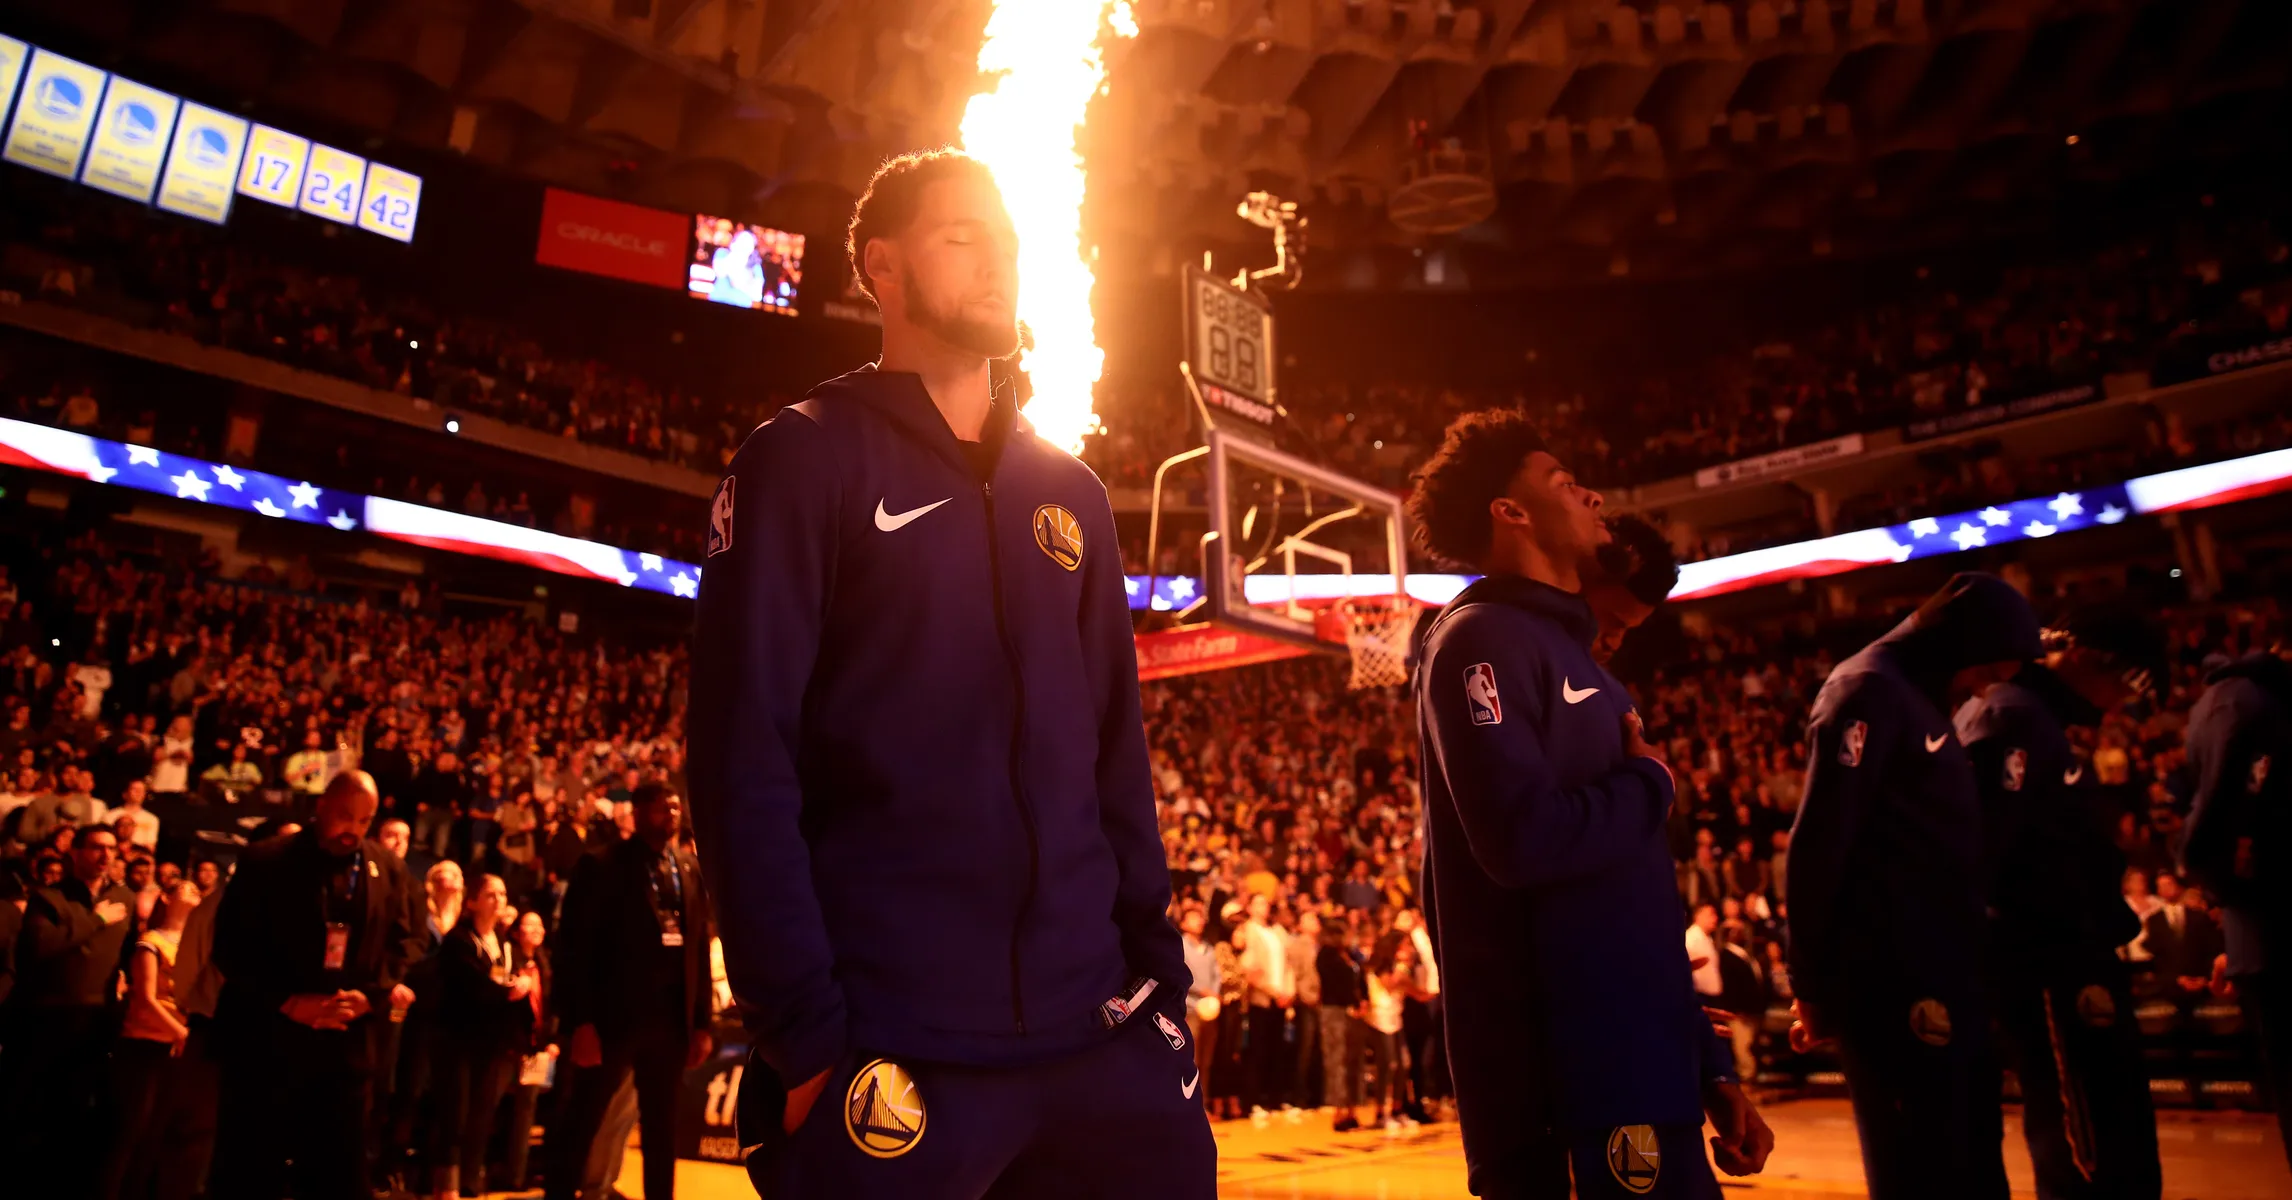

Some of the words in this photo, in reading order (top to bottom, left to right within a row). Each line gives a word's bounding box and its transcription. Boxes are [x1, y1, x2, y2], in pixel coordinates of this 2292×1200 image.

[252, 156, 290, 190] 17
[310, 173, 352, 211] 24
[370, 194, 410, 229] 42
[556, 221, 665, 258] ORACLE
[1475, 709, 1491, 722] NBA
